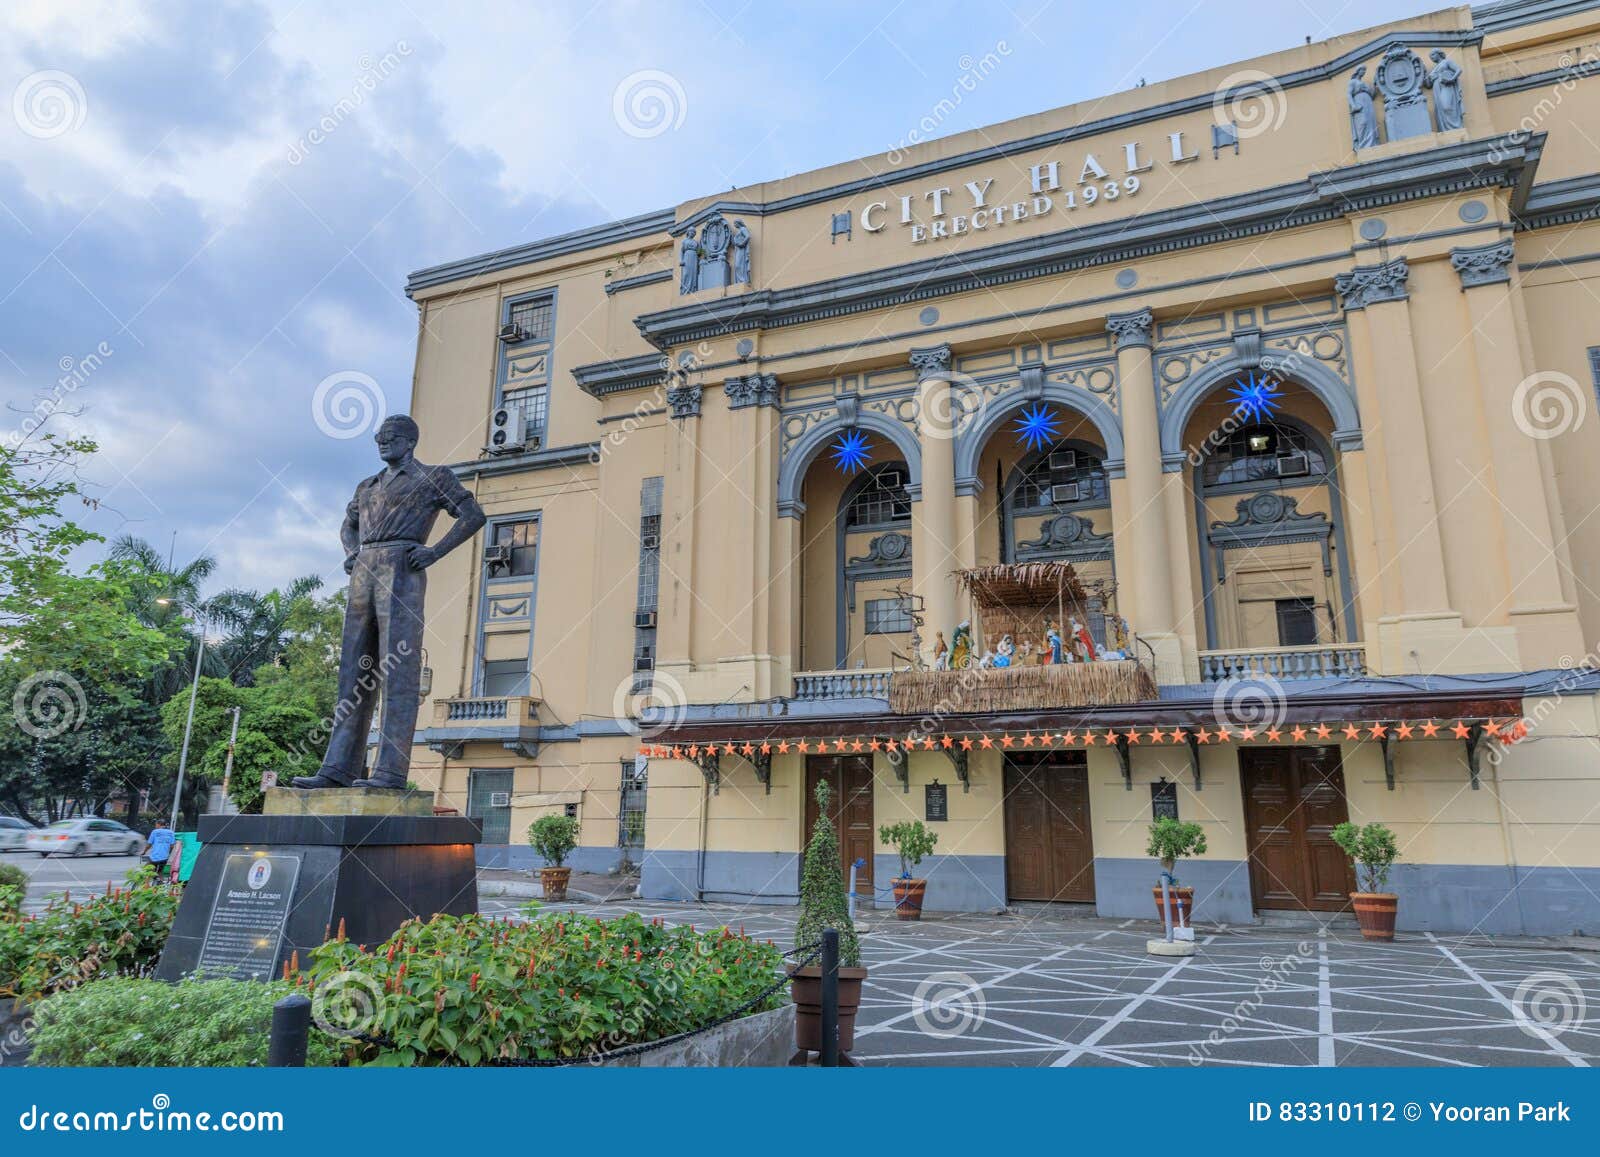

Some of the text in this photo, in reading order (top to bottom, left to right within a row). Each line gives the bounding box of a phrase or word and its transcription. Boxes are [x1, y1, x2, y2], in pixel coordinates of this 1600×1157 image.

[860, 131, 1200, 233] CITY HALL
[911, 175, 1141, 244] ERECTED 1939
